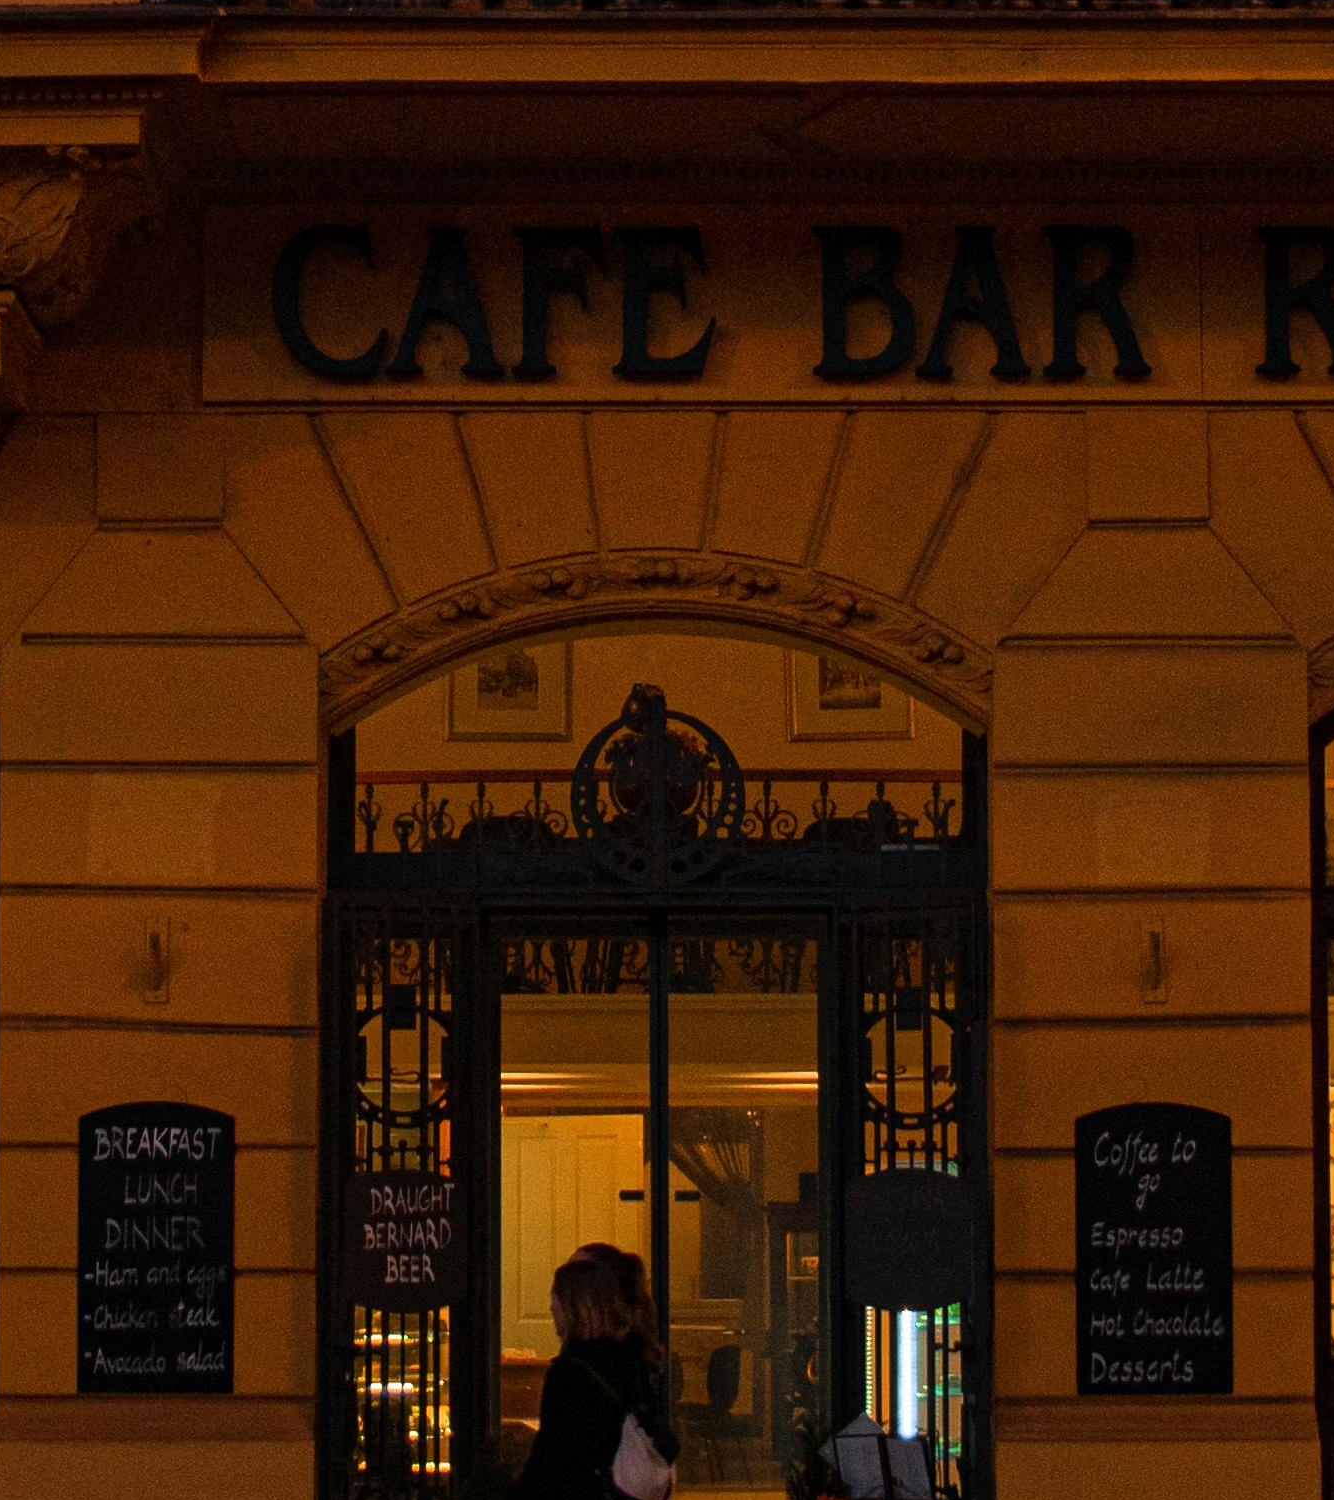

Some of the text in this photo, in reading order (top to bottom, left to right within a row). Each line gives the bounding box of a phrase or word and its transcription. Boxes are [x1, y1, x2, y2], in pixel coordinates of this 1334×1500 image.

[271, 221, 716, 382] CAFE
[813, 223, 1153, 382] BAR
[92, 1126, 222, 1161] BREAKFAST
[1093, 1130, 1197, 1176] Coffee to
[122, 1171, 199, 1206] LUNCH
[369, 1182, 456, 1217] DRAUGHT
[1134, 1171, 1162, 1209] go
[104, 1215, 208, 1251] DINNER
[363, 1217, 452, 1251] BERNARD
[1090, 1220, 1185, 1260] Espresso
[147, 1257, 181, 1283] and
[384, 1254, 436, 1284] BEER
[1147, 1264, 1206, 1293] Latte
[1089, 1305, 1226, 1338] Hot Chocolate
[1089, 1350, 1195, 1386] Desserts
